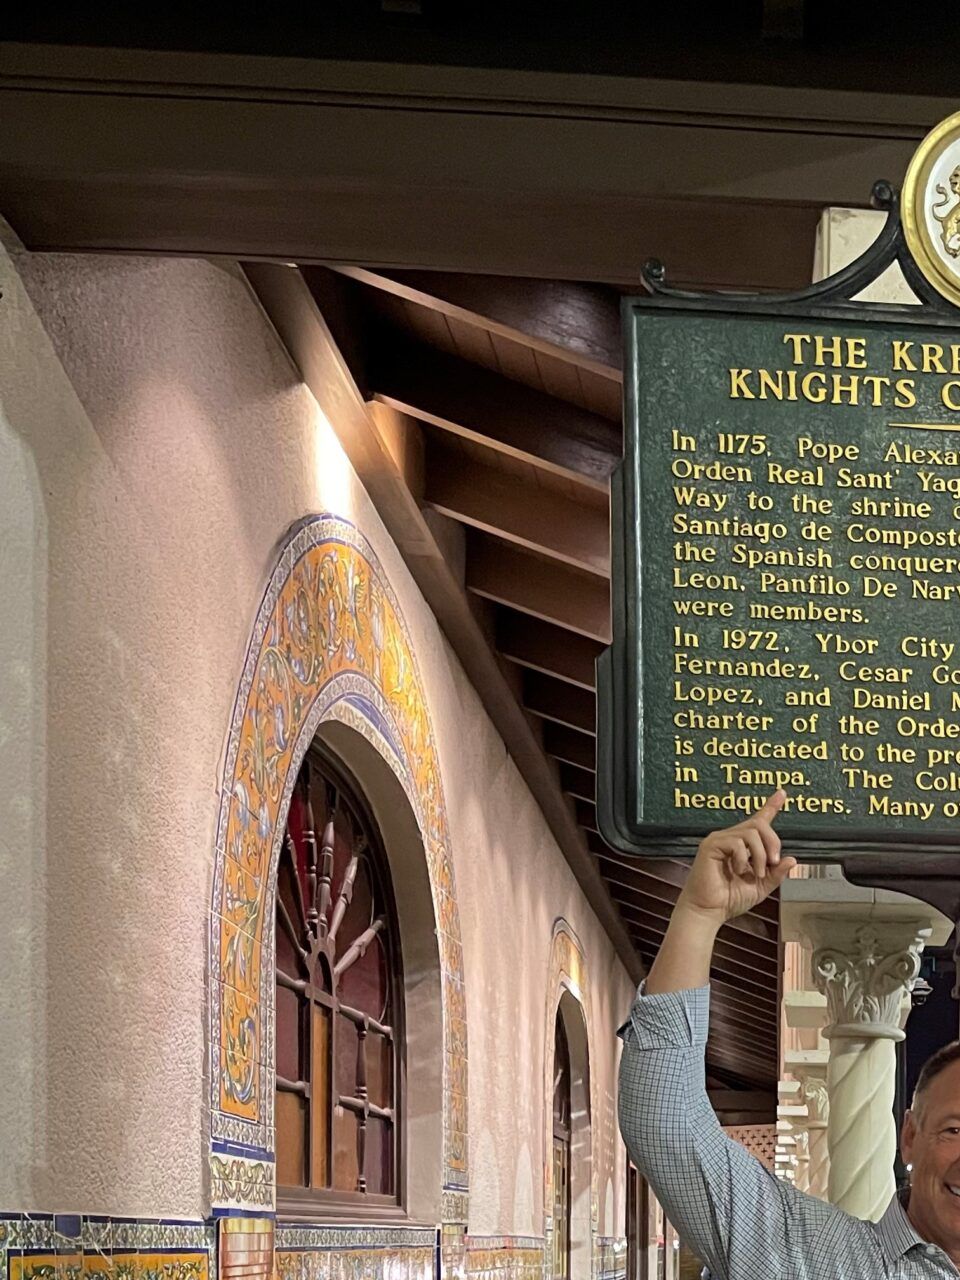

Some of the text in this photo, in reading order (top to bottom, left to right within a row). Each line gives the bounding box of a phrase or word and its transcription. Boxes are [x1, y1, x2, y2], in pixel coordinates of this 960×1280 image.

[783, 333, 868, 369] THE
[729, 367, 918, 408] KNIGHTS
[671, 428, 696, 452] In
[717, 432, 772, 456] 1175,
[797, 435, 860, 464] Pope
[671, 458, 753, 482] Orden
[767, 462, 824, 487] Real
[836, 467, 900, 489] Sant'
[672, 485, 727, 512] Way
[746, 490, 774, 511] to
[790, 492, 833, 515] the
[850, 496, 932, 518] shrine
[672, 512, 787, 544] Santiago
[800, 520, 833, 541] de
[672, 540, 717, 562] the
[731, 543, 833, 569] Spanish
[672, 567, 746, 592] Leon,
[760, 569, 851, 596] Panfilo
[863, 575, 898, 598] De
[672, 600, 869, 623] were members.
[674, 625, 699, 648] In
[722, 628, 790, 653] 1972,
[814, 632, 879, 654] Ybor
[901, 635, 955, 662] City
[674, 652, 820, 681] Fernandez,
[838, 660, 913, 683] Cesar
[673, 680, 763, 706] Lopez,
[784, 686, 831, 707] and
[853, 687, 931, 711] Daniel
[673, 708, 774, 731] charter
[792, 712, 819, 733] of
[837, 714, 880, 736] the
[674, 735, 694, 755] is
[703, 736, 829, 760] dedicated
[839, 742, 864, 762] to
[875, 742, 916, 763] the
[674, 760, 698, 782] in
[719, 762, 811, 789] Tampa.
[841, 767, 894, 789] The
[674, 787, 853, 814] headqurters.
[868, 795, 935, 821] Many
